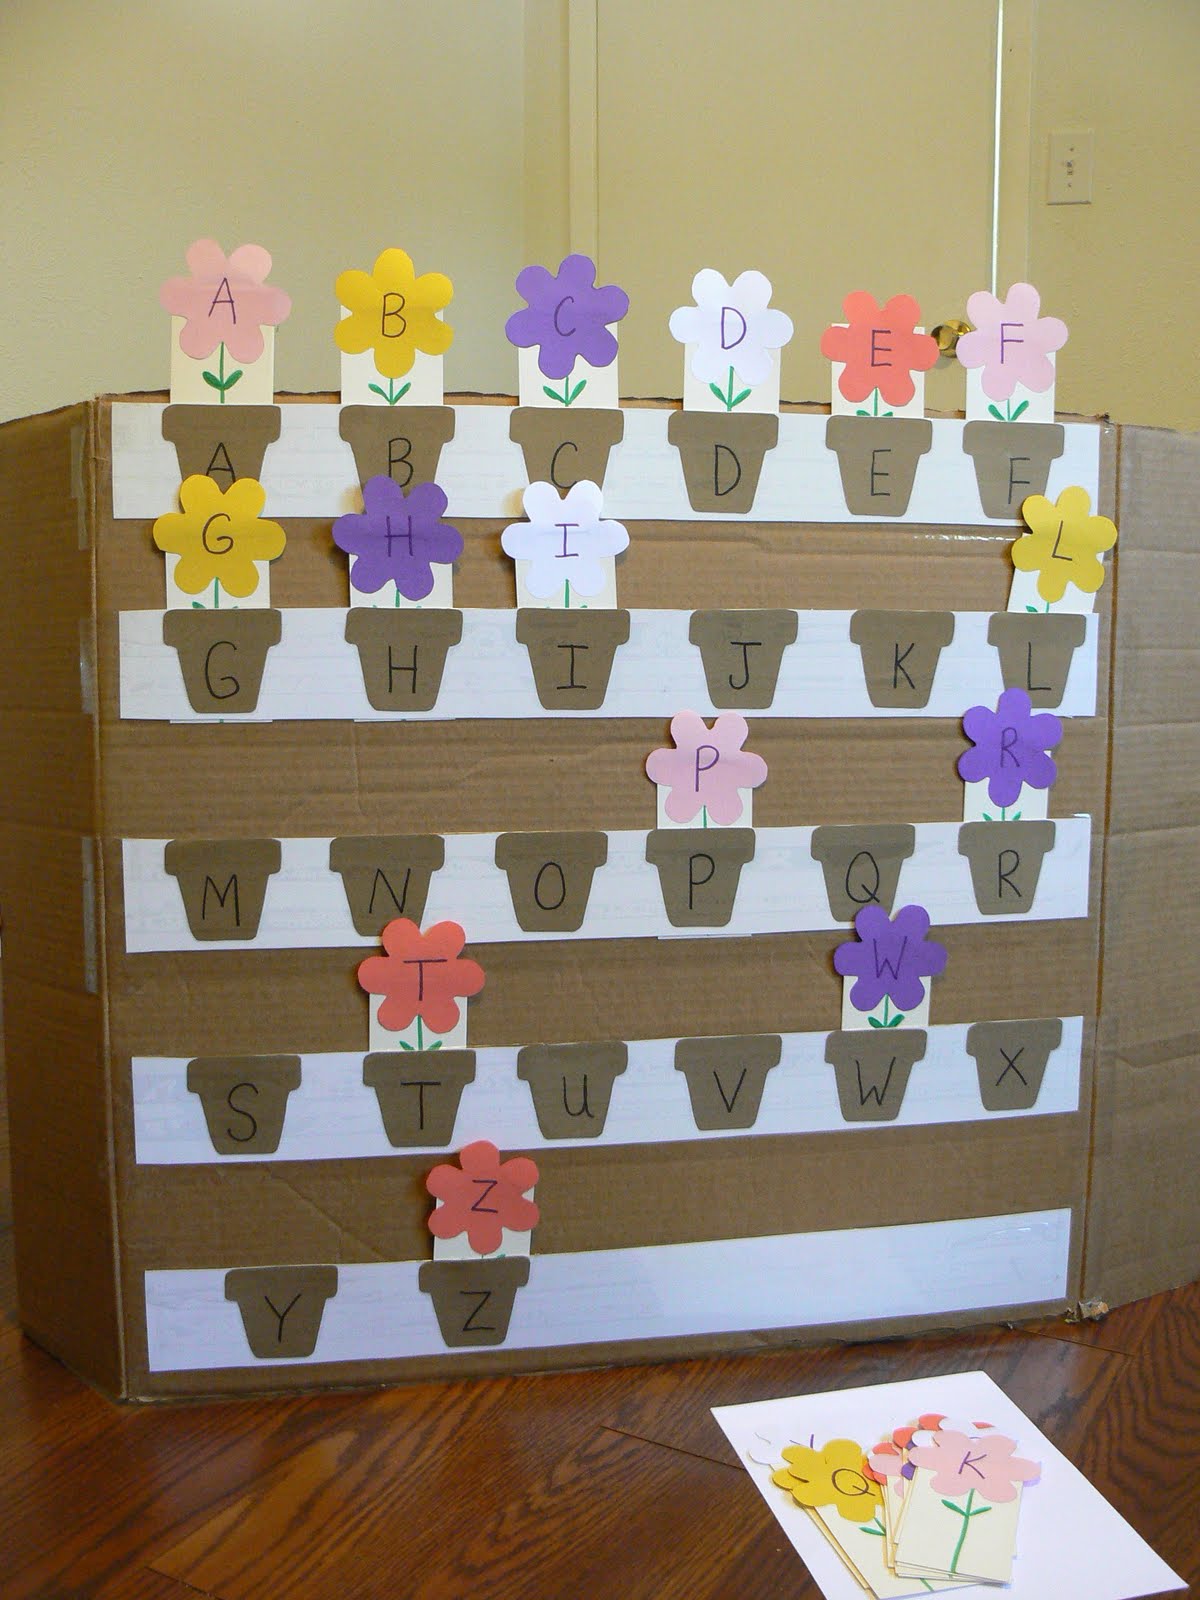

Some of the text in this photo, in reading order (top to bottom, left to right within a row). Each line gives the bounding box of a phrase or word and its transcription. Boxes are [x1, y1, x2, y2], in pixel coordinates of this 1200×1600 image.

[208, 277, 236, 324] A
[382, 293, 407, 338] B
[555, 295, 576, 337] C
[721, 306, 747, 350] D
[871, 329, 892, 367] E
[1000, 323, 1024, 364] F
[206, 437, 1030, 504] A B C D E F
[202, 513, 234, 555] G
[386, 515, 412, 558] H
[555, 523, 580, 558] I
[1051, 520, 1073, 561] L
[205, 641, 1051, 699] G H I J K L
[695, 745, 719, 792] P
[1000, 727, 1020, 768] R
[201, 849, 1021, 926] M N O P Q R
[873, 936, 907, 980] W
[403, 959, 447, 1001] T
[227, 1083, 259, 1142] S
[400, 1082, 441, 1130] T
[713, 1069, 747, 1113] V
[855, 1056, 896, 1106] W
[995, 1047, 1027, 1086] X
[471, 1179, 498, 1214] Z
[265, 1290, 496, 1343] Y Z
[832, 1468, 876, 1496] Q
[958, 1451, 987, 1479] K
